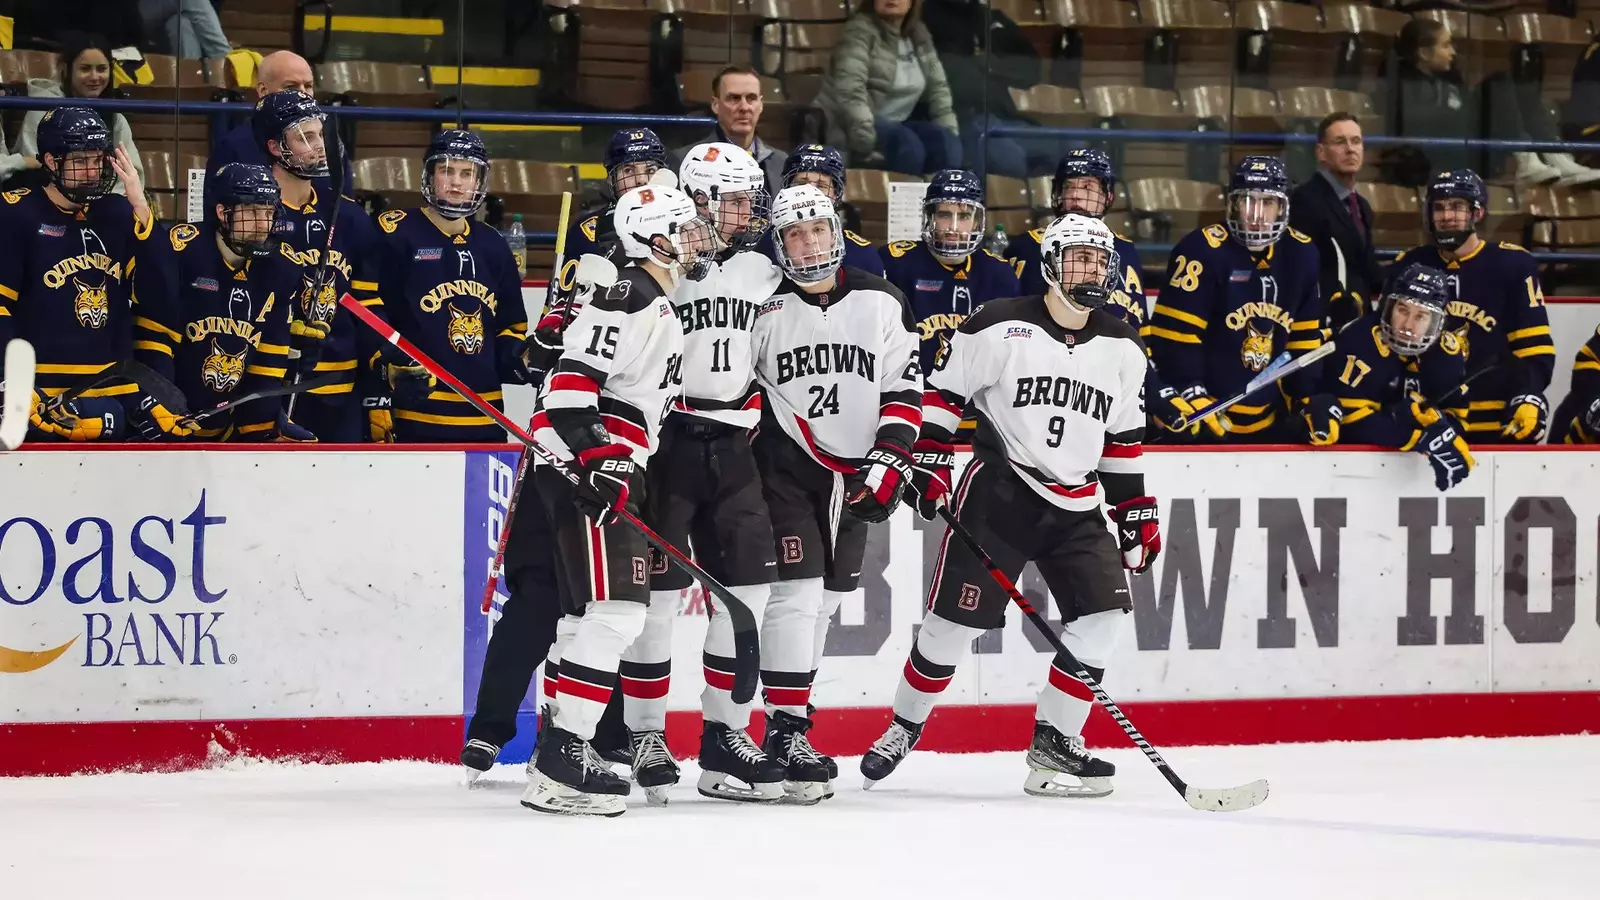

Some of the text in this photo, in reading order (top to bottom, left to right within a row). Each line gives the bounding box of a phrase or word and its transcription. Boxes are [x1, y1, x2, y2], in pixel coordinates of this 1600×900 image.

[639, 188, 655, 205] B
[792, 199, 816, 211] BEARS
[1087, 228, 1109, 239] BEARS
[43, 252, 122, 289] QUINNIPIA
[1125, 265, 1143, 295] A
[1170, 255, 1204, 292] 28
[1409, 284, 1430, 294] CCM
[185, 316, 262, 348] QUINNIPIA
[585, 324, 620, 360] 15
[1007, 326, 1033, 335] ECAC
[711, 337, 732, 373] 11
[776, 343, 876, 385] BROWN
[1338, 354, 1372, 388] 17
[807, 382, 840, 419] 24
[1012, 375, 1113, 425] BROWN
[1046, 415, 1066, 449] 9
[600, 459, 635, 474] BAU
[867, 450, 913, 484] BAUE
[1125, 506, 1159, 522] BAU
[0, 487, 229, 606] oast
[782, 535, 803, 563] B
[631, 556, 647, 585] B
[1396, 495, 1600, 647] HO
[957, 582, 982, 612] B
[80, 611, 226, 667] BANK
